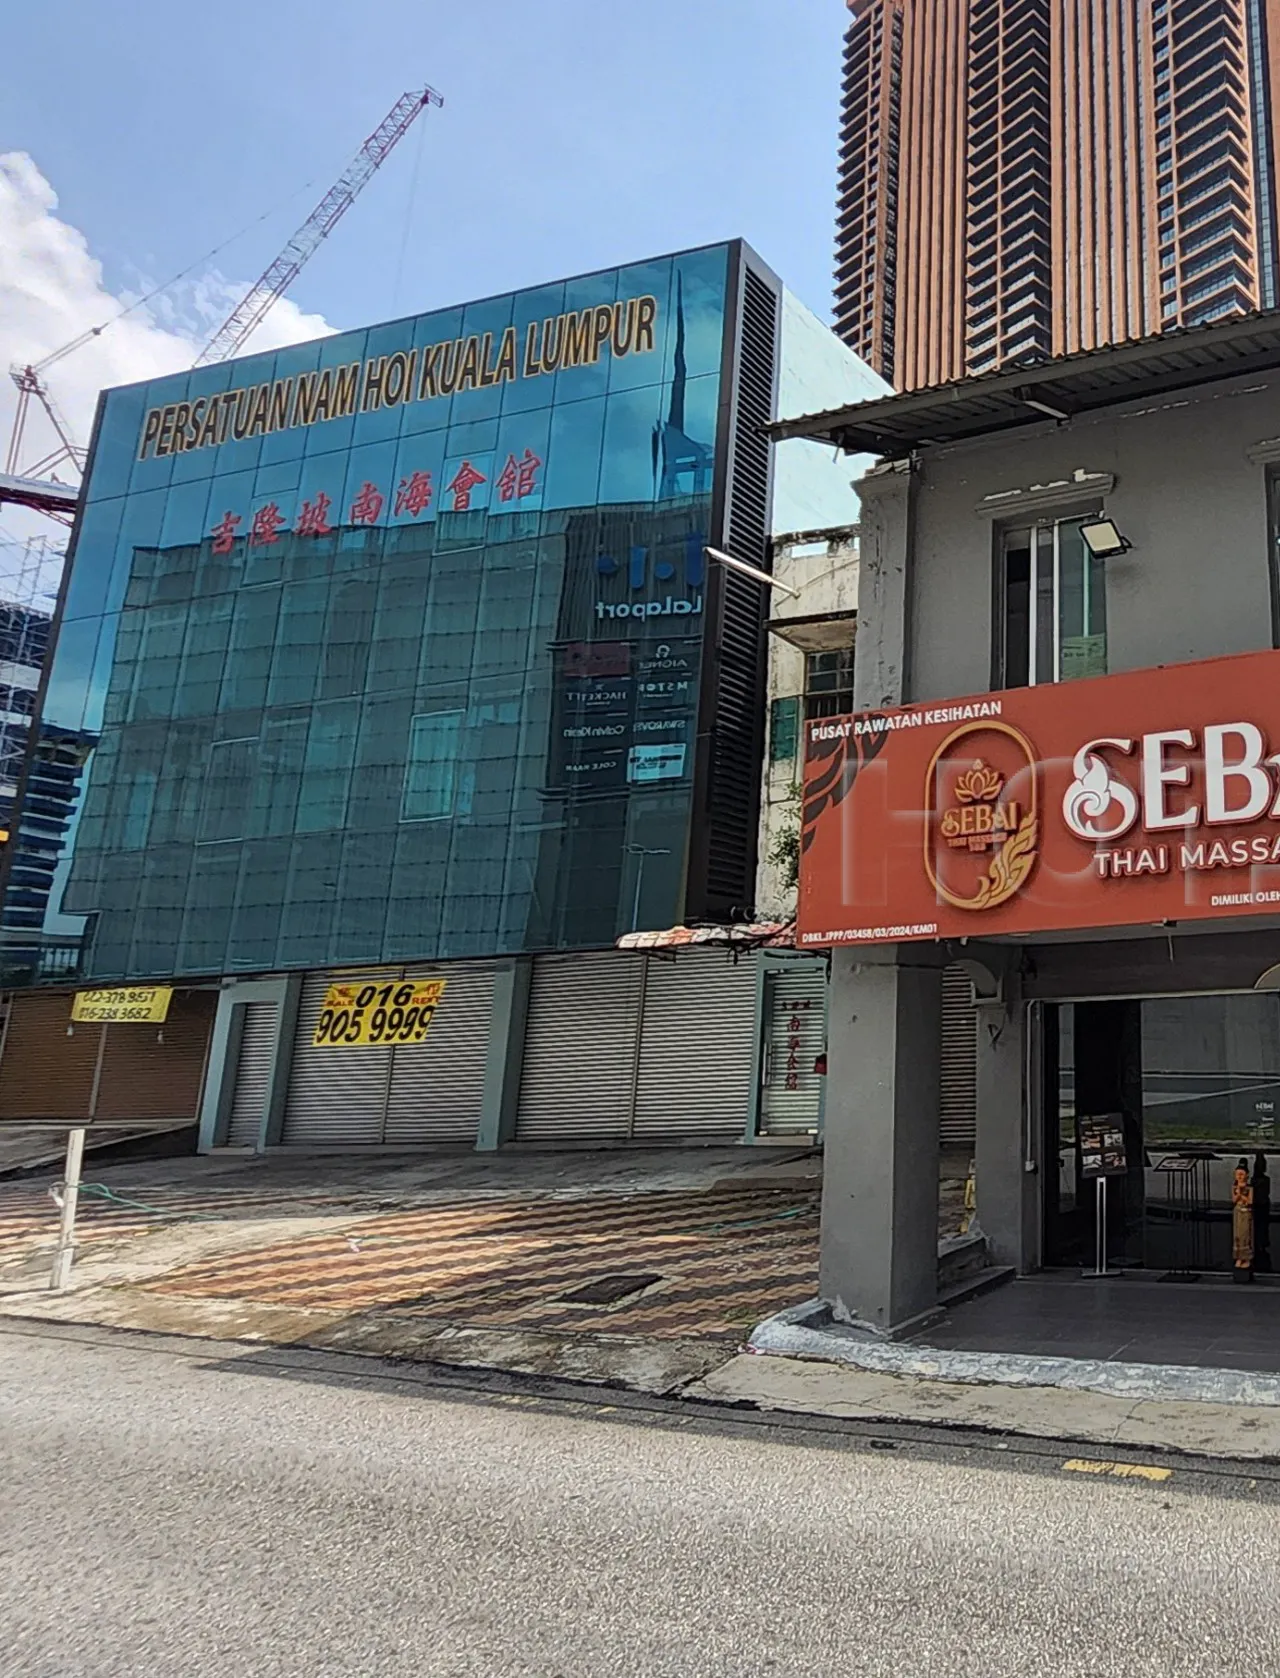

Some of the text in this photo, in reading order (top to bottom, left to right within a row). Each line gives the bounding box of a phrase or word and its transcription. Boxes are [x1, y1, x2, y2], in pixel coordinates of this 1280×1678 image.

[136, 294, 656, 461] PERSATUAN NAM HOI KUALA LUMPUR
[811, 700, 1001, 741] PUSAT RAWATAN KESIHATAN
[941, 801, 1017, 837] SEBAI
[1094, 847, 1166, 876] THAI
[1211, 892, 1254, 906] DIMILIKI
[355, 983, 416, 1008] 016
[316, 1005, 436, 1044] 905 9999
